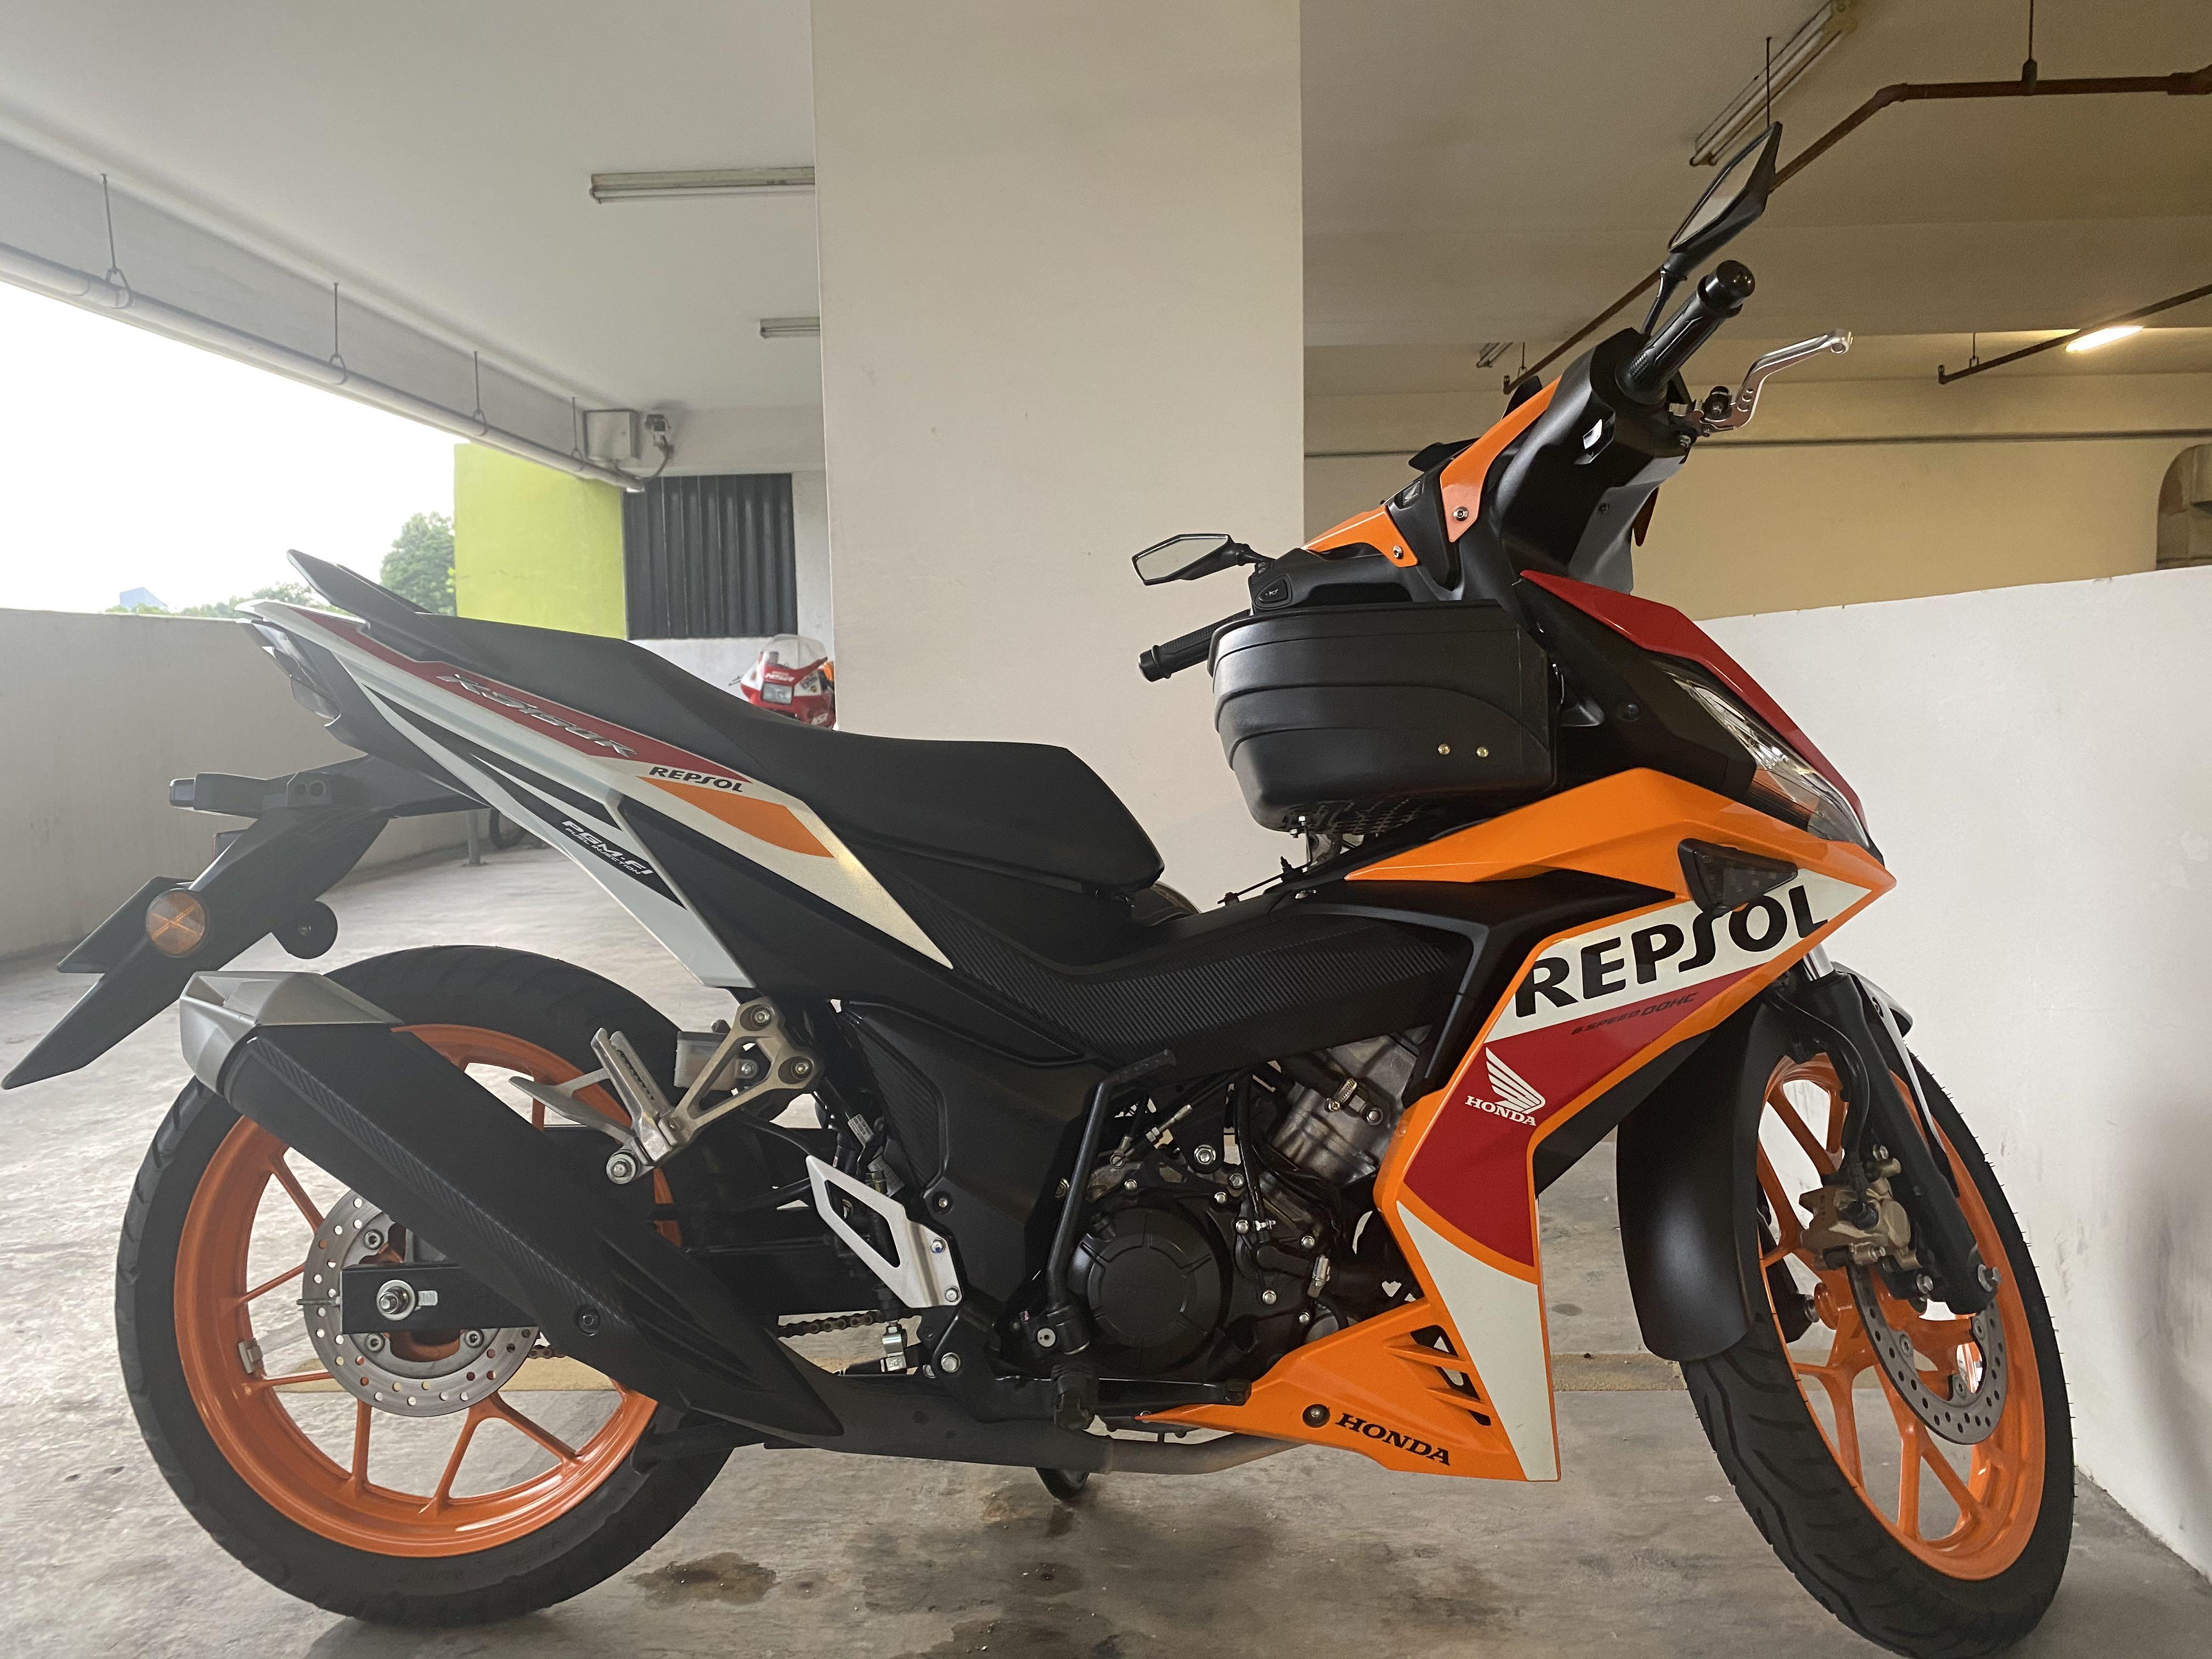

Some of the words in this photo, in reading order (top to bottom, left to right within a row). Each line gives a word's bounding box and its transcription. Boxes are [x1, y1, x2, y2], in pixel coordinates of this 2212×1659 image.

[649, 766, 743, 792] REPSOL
[565, 828, 590, 845] FUEL
[591, 844, 641, 874] INJECTION
[1515, 885, 1828, 1018] REPSOL
[1584, 1009, 1641, 1031] SPEED
[1641, 992, 1697, 1017] DOHC
[1465, 1095, 1536, 1126] HONDA
[1335, 1413, 1451, 1466] HONDA
